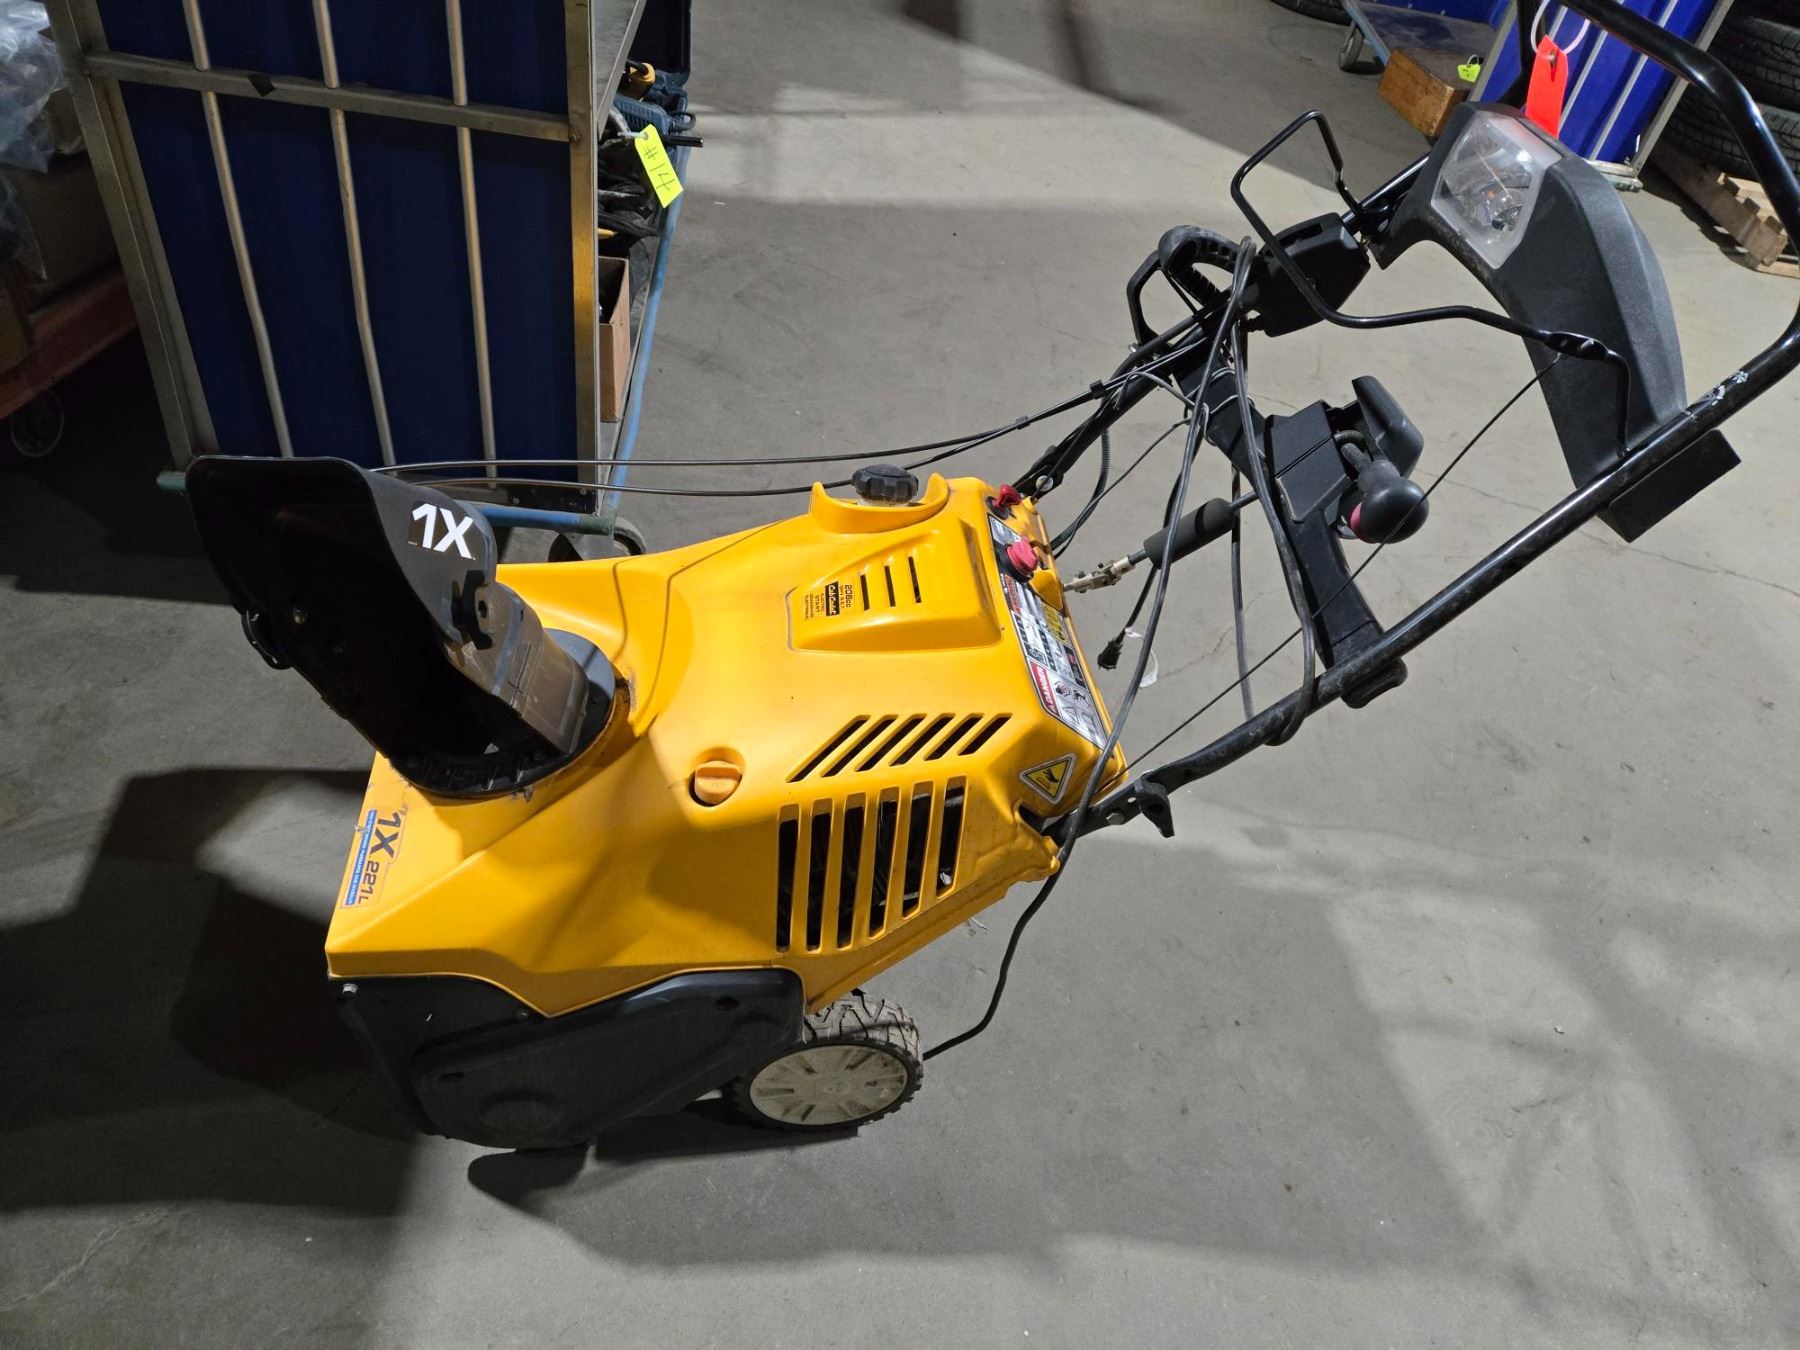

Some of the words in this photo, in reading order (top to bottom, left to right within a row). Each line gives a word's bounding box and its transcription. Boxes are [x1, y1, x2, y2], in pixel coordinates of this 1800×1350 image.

[644, 146, 676, 191] #14
[412, 503, 474, 559] 1X
[828, 584, 837, 597] Cub
[828, 596, 838, 615] Cadet
[845, 584, 853, 608] 208cc
[370, 811, 402, 859] 1X
